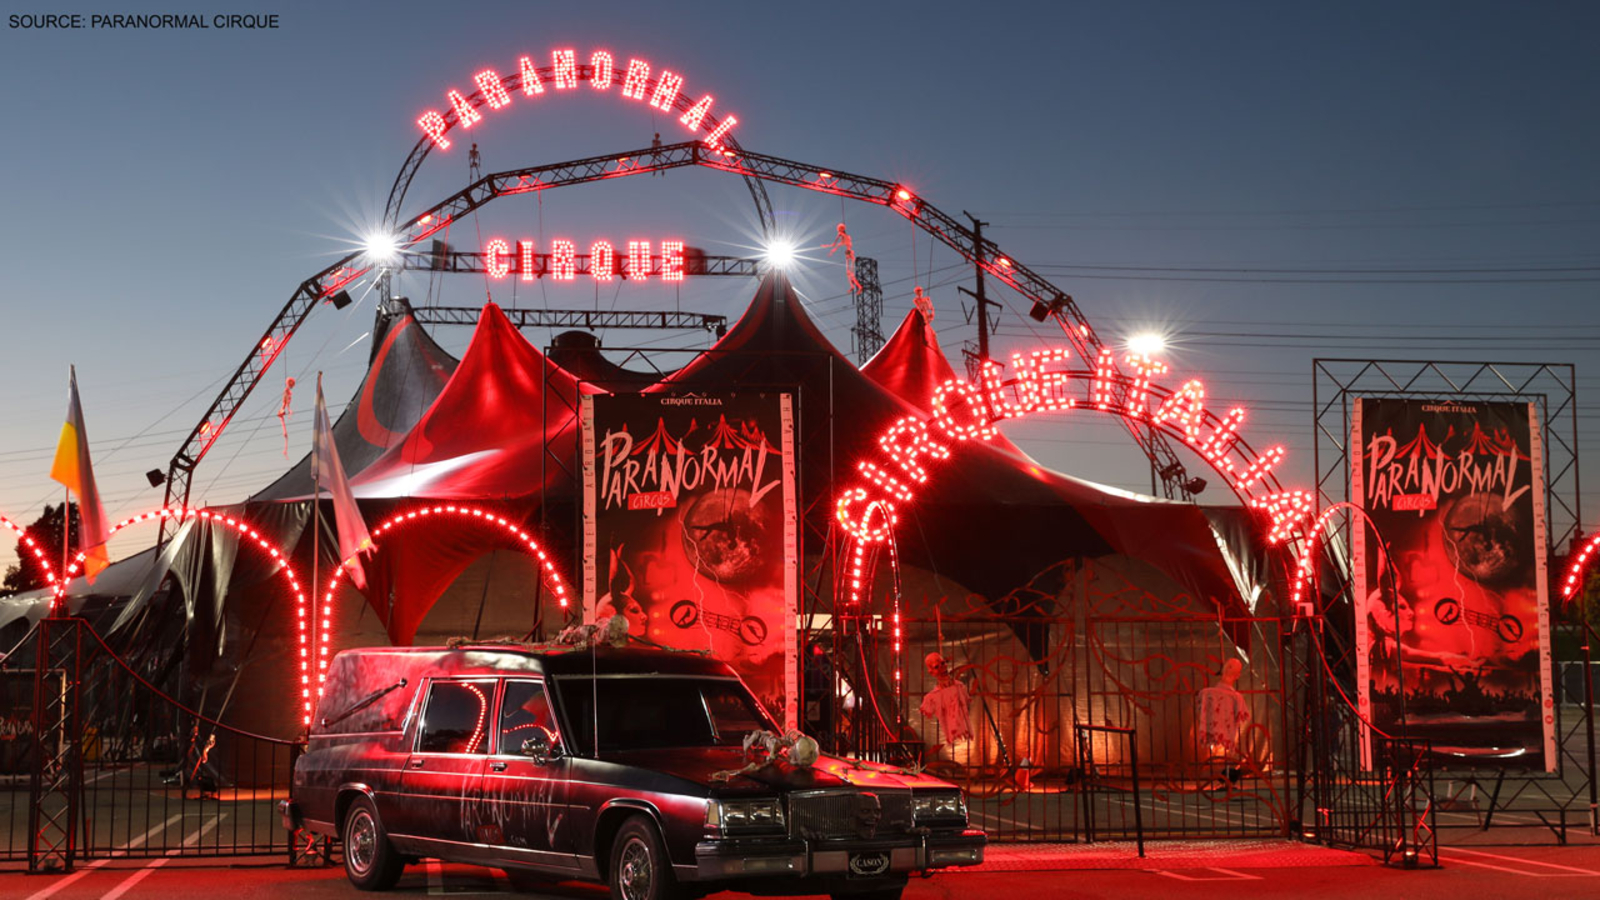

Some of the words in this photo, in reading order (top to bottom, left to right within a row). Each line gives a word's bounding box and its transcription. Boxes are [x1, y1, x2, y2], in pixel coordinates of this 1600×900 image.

[417, 49, 738, 155] PARANORMAL
[486, 238, 685, 281] CIRQUE
[660, 397, 693, 407] CIRQUE
[694, 397, 722, 406] ITALIA
[1421, 404, 1451, 414] CIRQUE
[1452, 406, 1477, 414] ITALIA
[836, 348, 1076, 542] CIRQUE
[1095, 348, 1313, 544] ITALIA
[600, 428, 781, 517] PARANORMAL
[1366, 432, 1531, 518] PARANORMAL
[632, 493, 671, 509] CIRCUS
[1396, 497, 1432, 510] CIRCUS
